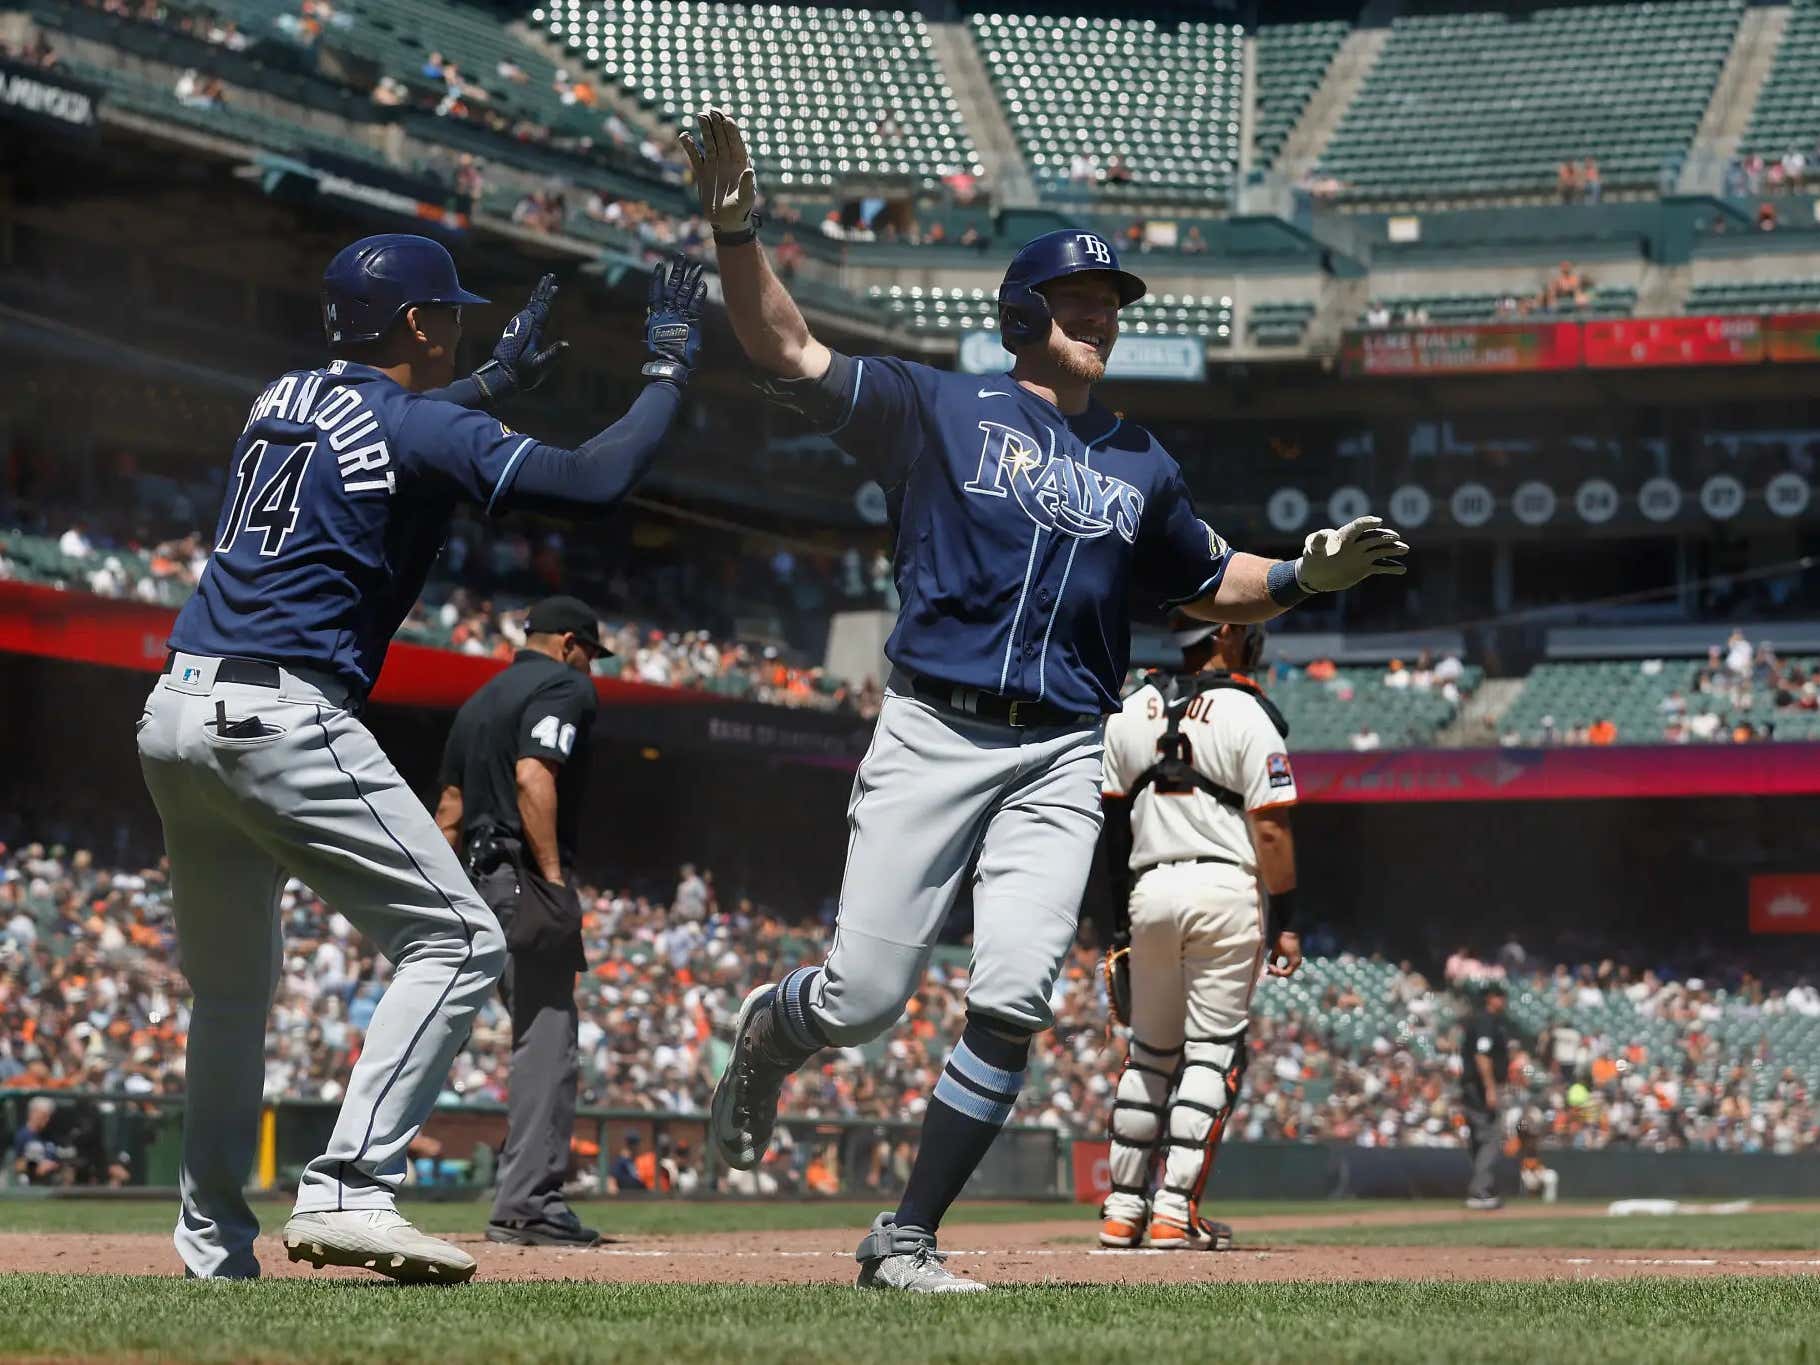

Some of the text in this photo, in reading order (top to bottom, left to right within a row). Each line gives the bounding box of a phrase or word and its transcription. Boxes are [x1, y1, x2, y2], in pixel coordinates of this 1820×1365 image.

[1075, 234, 1111, 264] TB
[655, 327, 687, 340] Franklin
[214, 440, 317, 556] 14
[1147, 694, 1214, 724] SOL
[531, 716, 576, 755] 40
